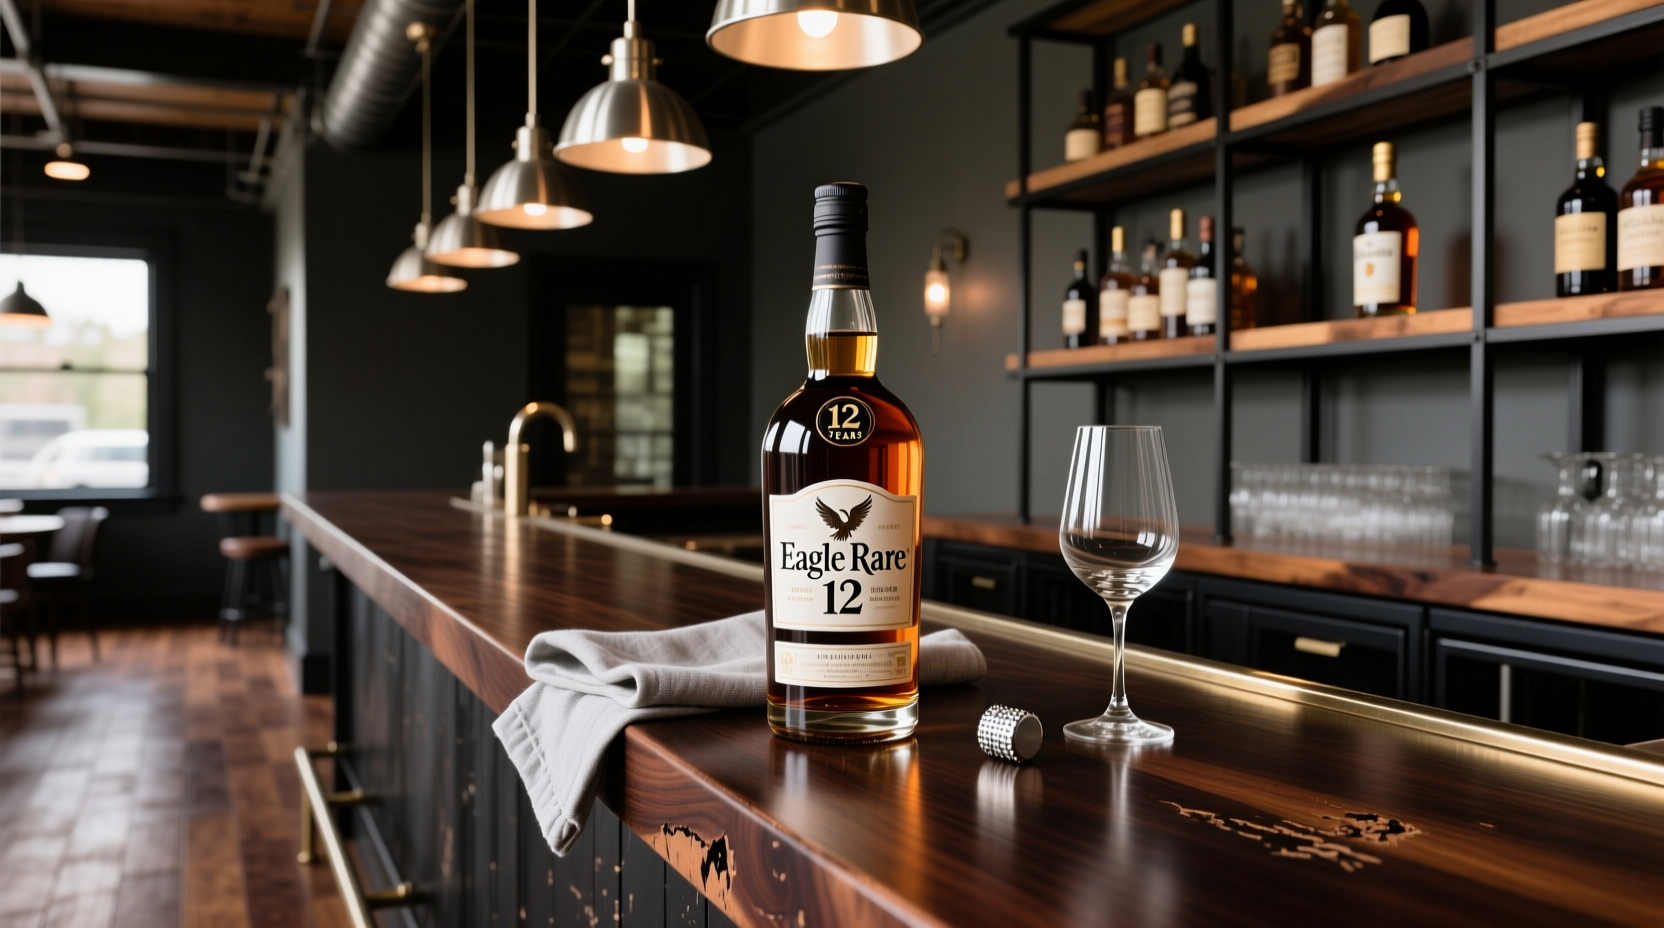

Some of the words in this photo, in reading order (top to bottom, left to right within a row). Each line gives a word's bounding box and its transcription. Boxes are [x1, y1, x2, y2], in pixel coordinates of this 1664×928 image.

[828, 403, 861, 429] 12
[780, 541, 846, 580] Eagle
[850, 542, 907, 576] Rare
[822, 579, 863, 615] 12
